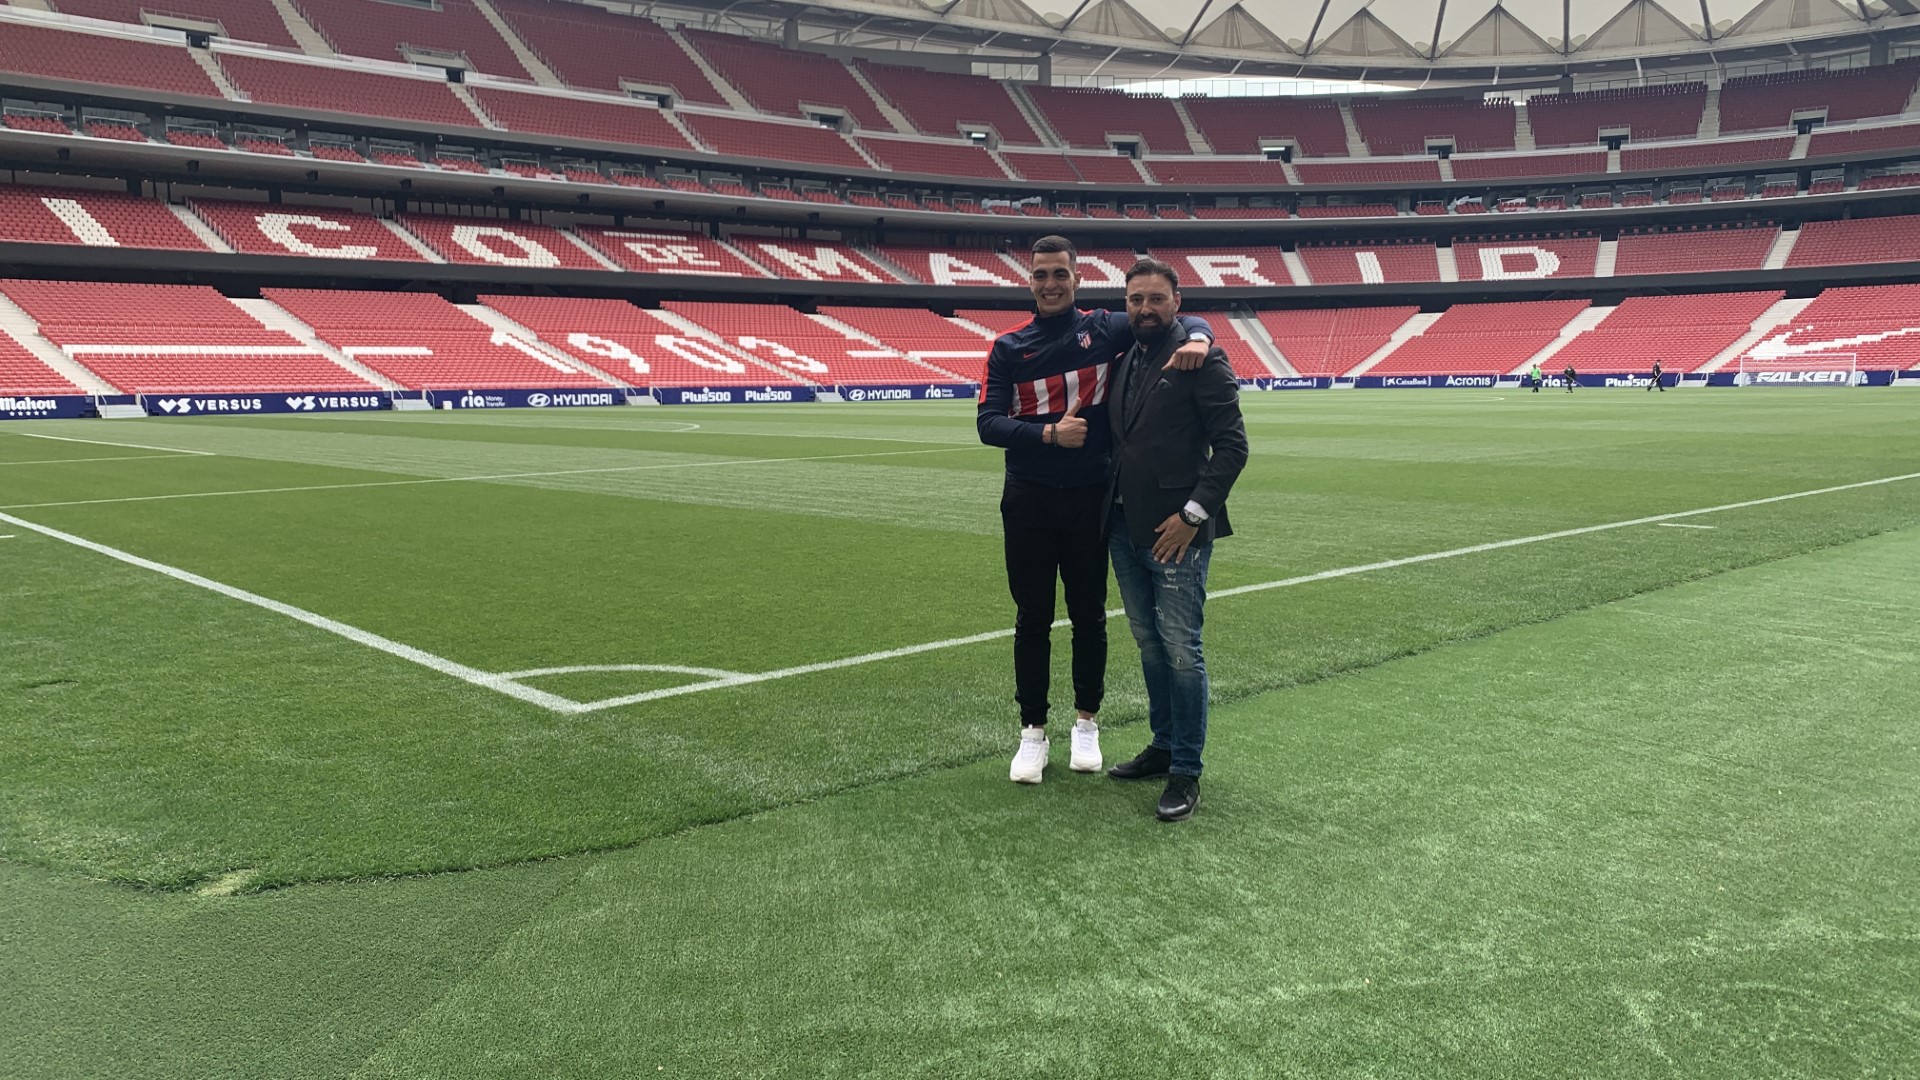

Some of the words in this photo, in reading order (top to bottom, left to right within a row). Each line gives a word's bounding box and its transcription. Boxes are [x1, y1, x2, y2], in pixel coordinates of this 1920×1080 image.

[624, 243, 720, 267] DE
[758, 246, 1561, 288] MADRID
[490, 331, 829, 375] 1903
[1282, 379, 1312, 387] CaixaBank
[1396, 377, 1427, 386] CaixaBank
[1445, 374, 1491, 387] Acronis
[1756, 371, 1847, 383] FALKEN
[681, 390, 731, 403] Plus500
[745, 389, 792, 402] Plus500
[867, 389, 912, 399] HYUNDAI
[925, 384, 942, 398] ria
[0, 396, 57, 411] Mahou
[195, 398, 262, 411] VERSUS
[318, 396, 379, 408] VERSUS
[461, 389, 485, 408] ria
[553, 394, 612, 405] HYUNDAI
